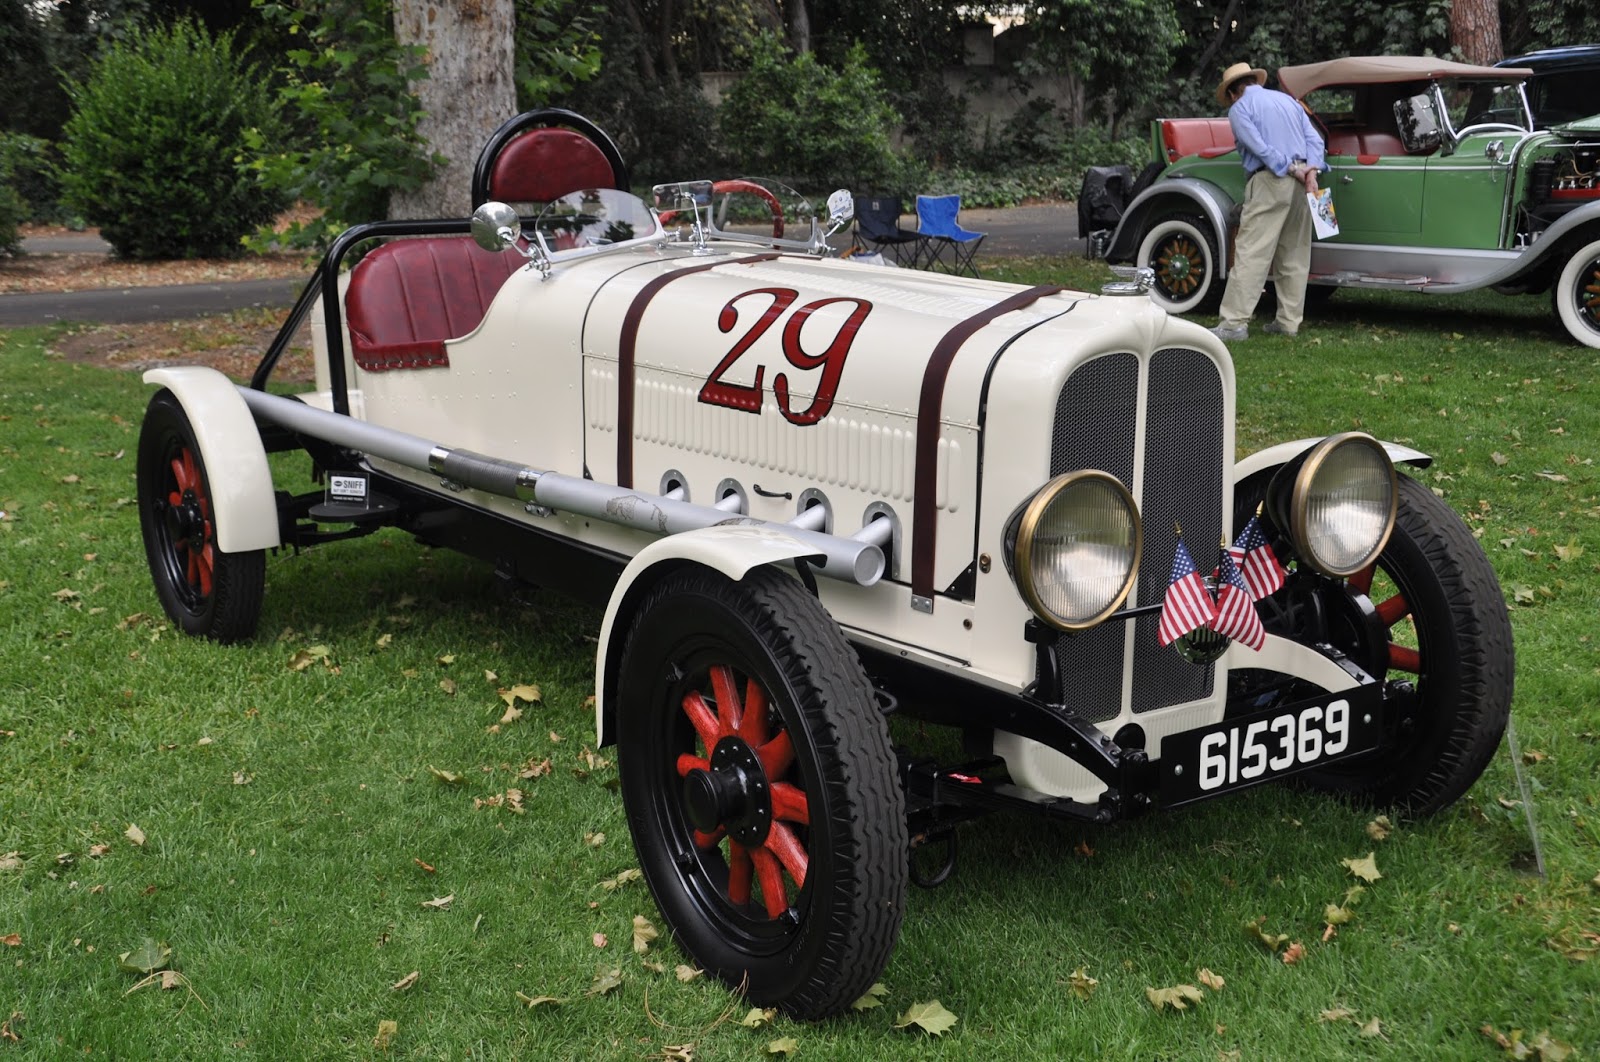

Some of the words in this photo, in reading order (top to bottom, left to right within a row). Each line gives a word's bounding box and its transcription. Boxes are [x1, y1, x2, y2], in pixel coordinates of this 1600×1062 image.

[698, 287, 873, 426] 29
[343, 480, 363, 489] SNIFF
[1199, 699, 1349, 791] 615369
